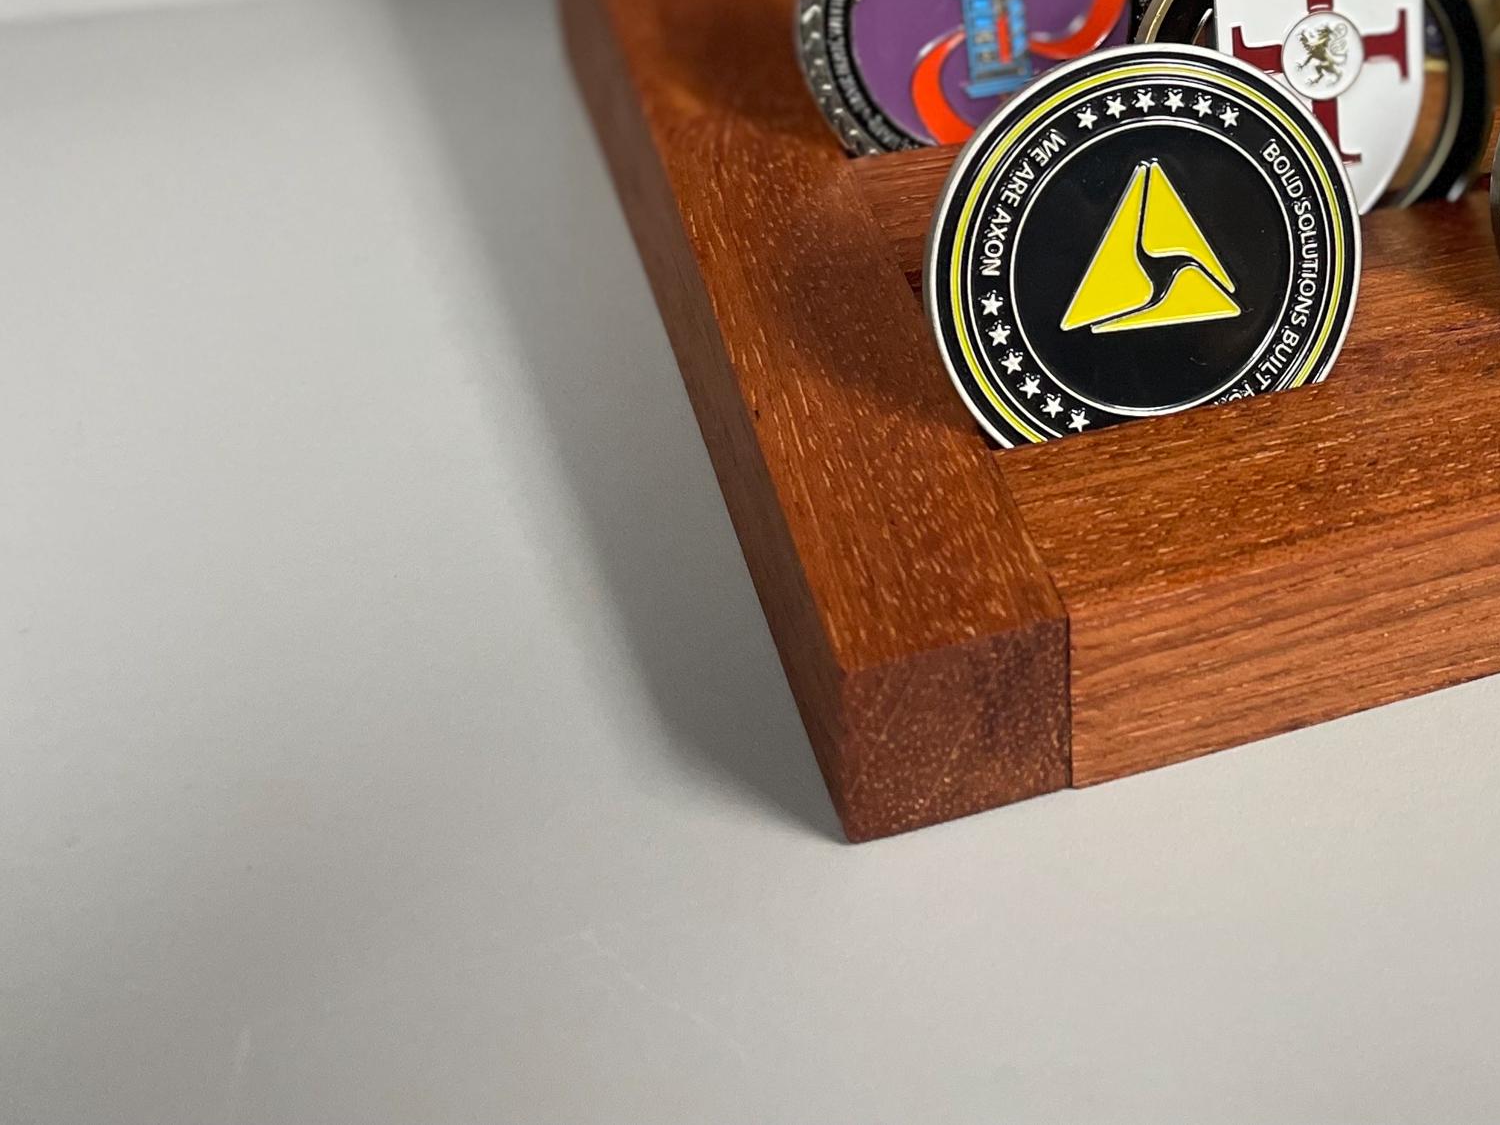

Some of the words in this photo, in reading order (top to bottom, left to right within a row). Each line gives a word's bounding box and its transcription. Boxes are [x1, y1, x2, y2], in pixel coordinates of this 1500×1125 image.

[1028, 129, 1067, 167] WE
[1261, 140, 1304, 199] BOLD
[1000, 160, 1035, 208] ARE
[981, 205, 1013, 277] AXON
[1291, 198, 1320, 328] SOLUTIONS
[1255, 325, 1300, 391] BUILT
